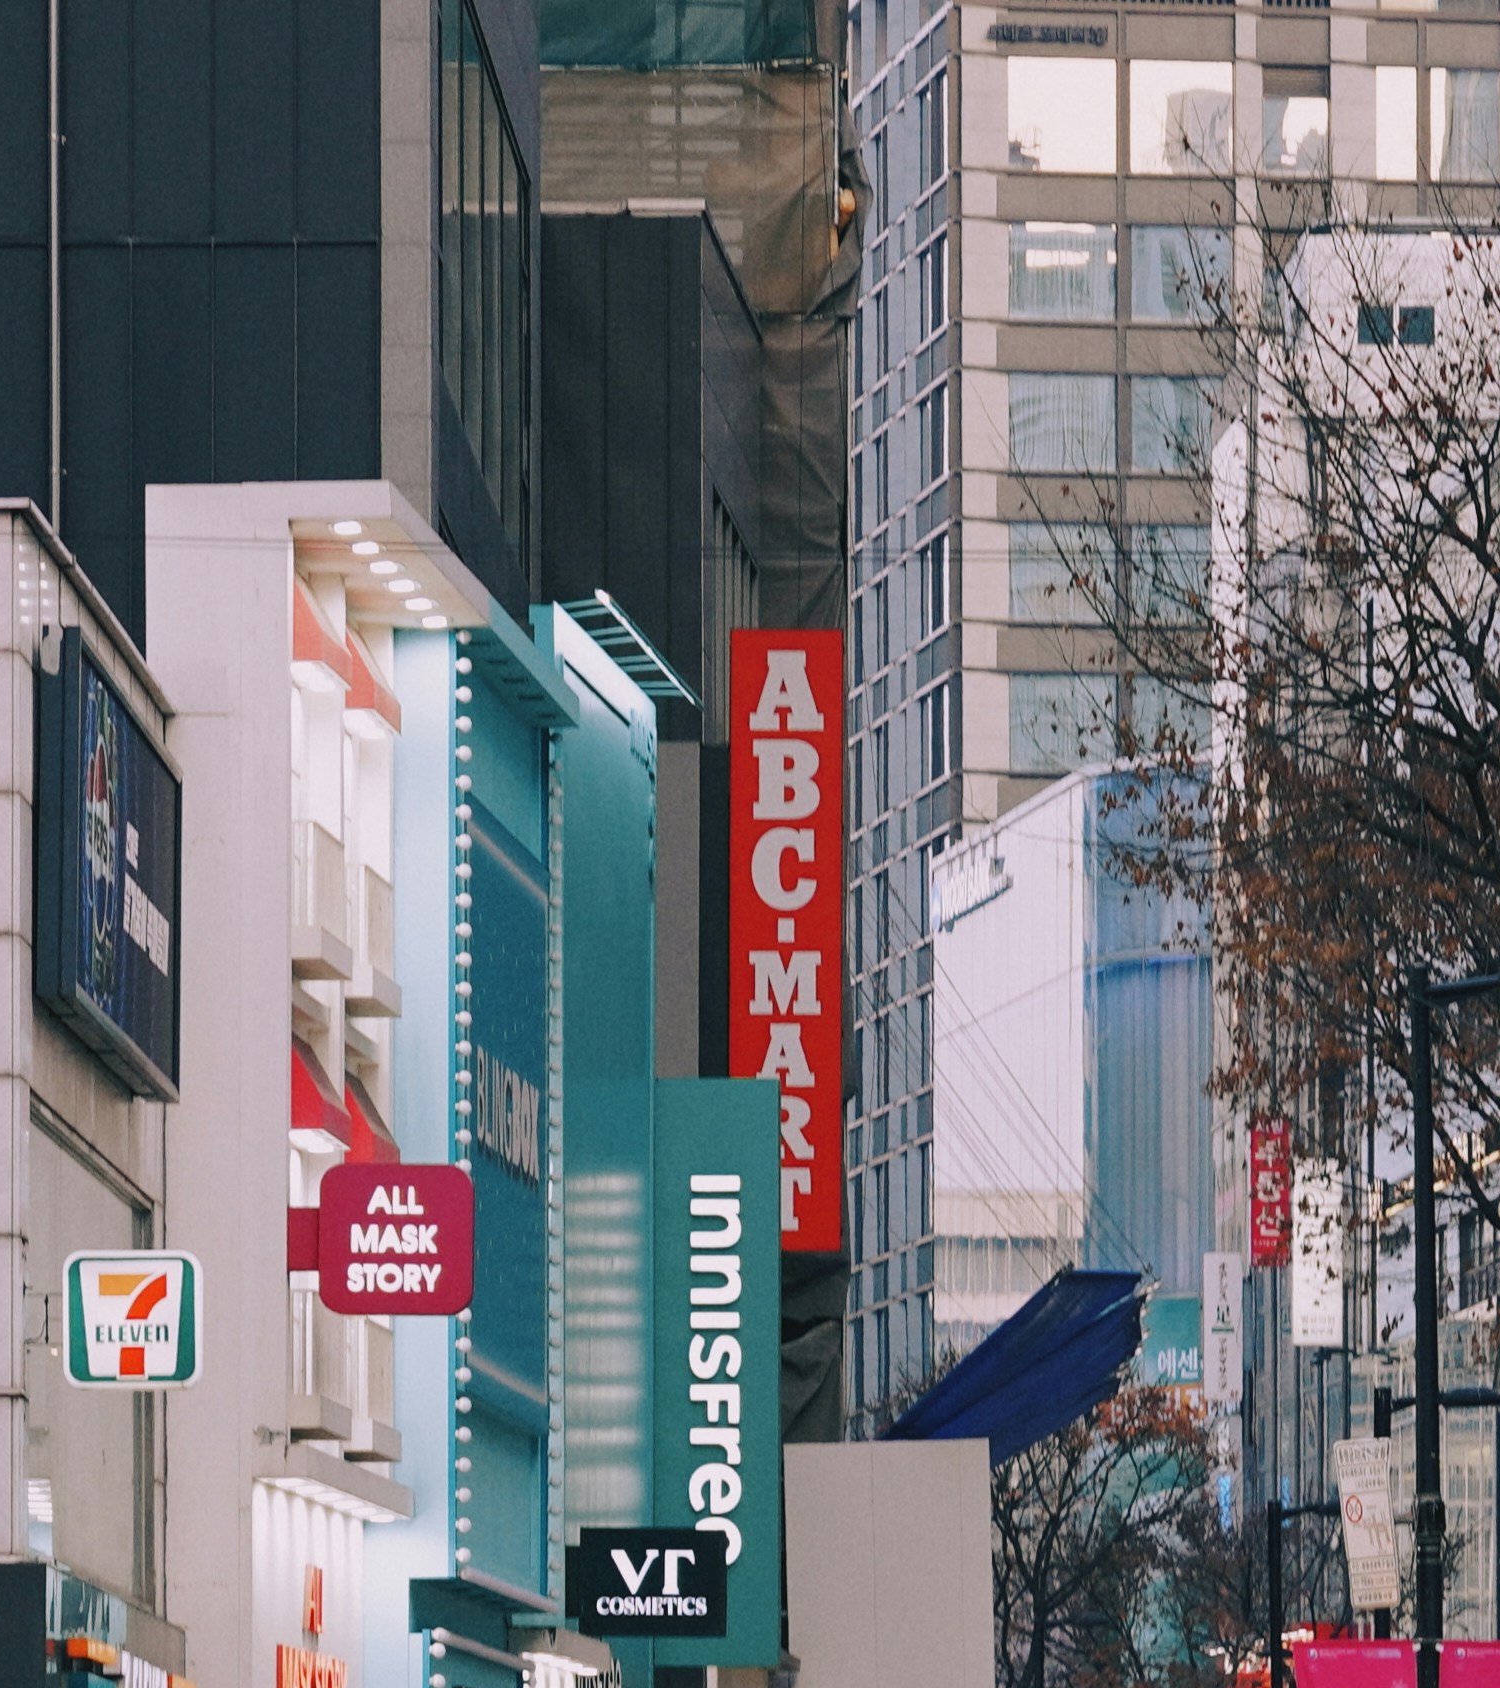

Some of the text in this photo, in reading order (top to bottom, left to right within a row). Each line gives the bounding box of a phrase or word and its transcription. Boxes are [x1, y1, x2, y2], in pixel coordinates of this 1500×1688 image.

[476, 1045, 541, 1185] BLINGBOX
[367, 1186, 425, 1216] ALL
[349, 1224, 438, 1255] MASK
[346, 1262, 442, 1294] STORY
[1157, 1347, 1202, 1380] 에센
[610, 1549, 696, 1595] VT
[596, 1596, 708, 1617] COSMETICS
